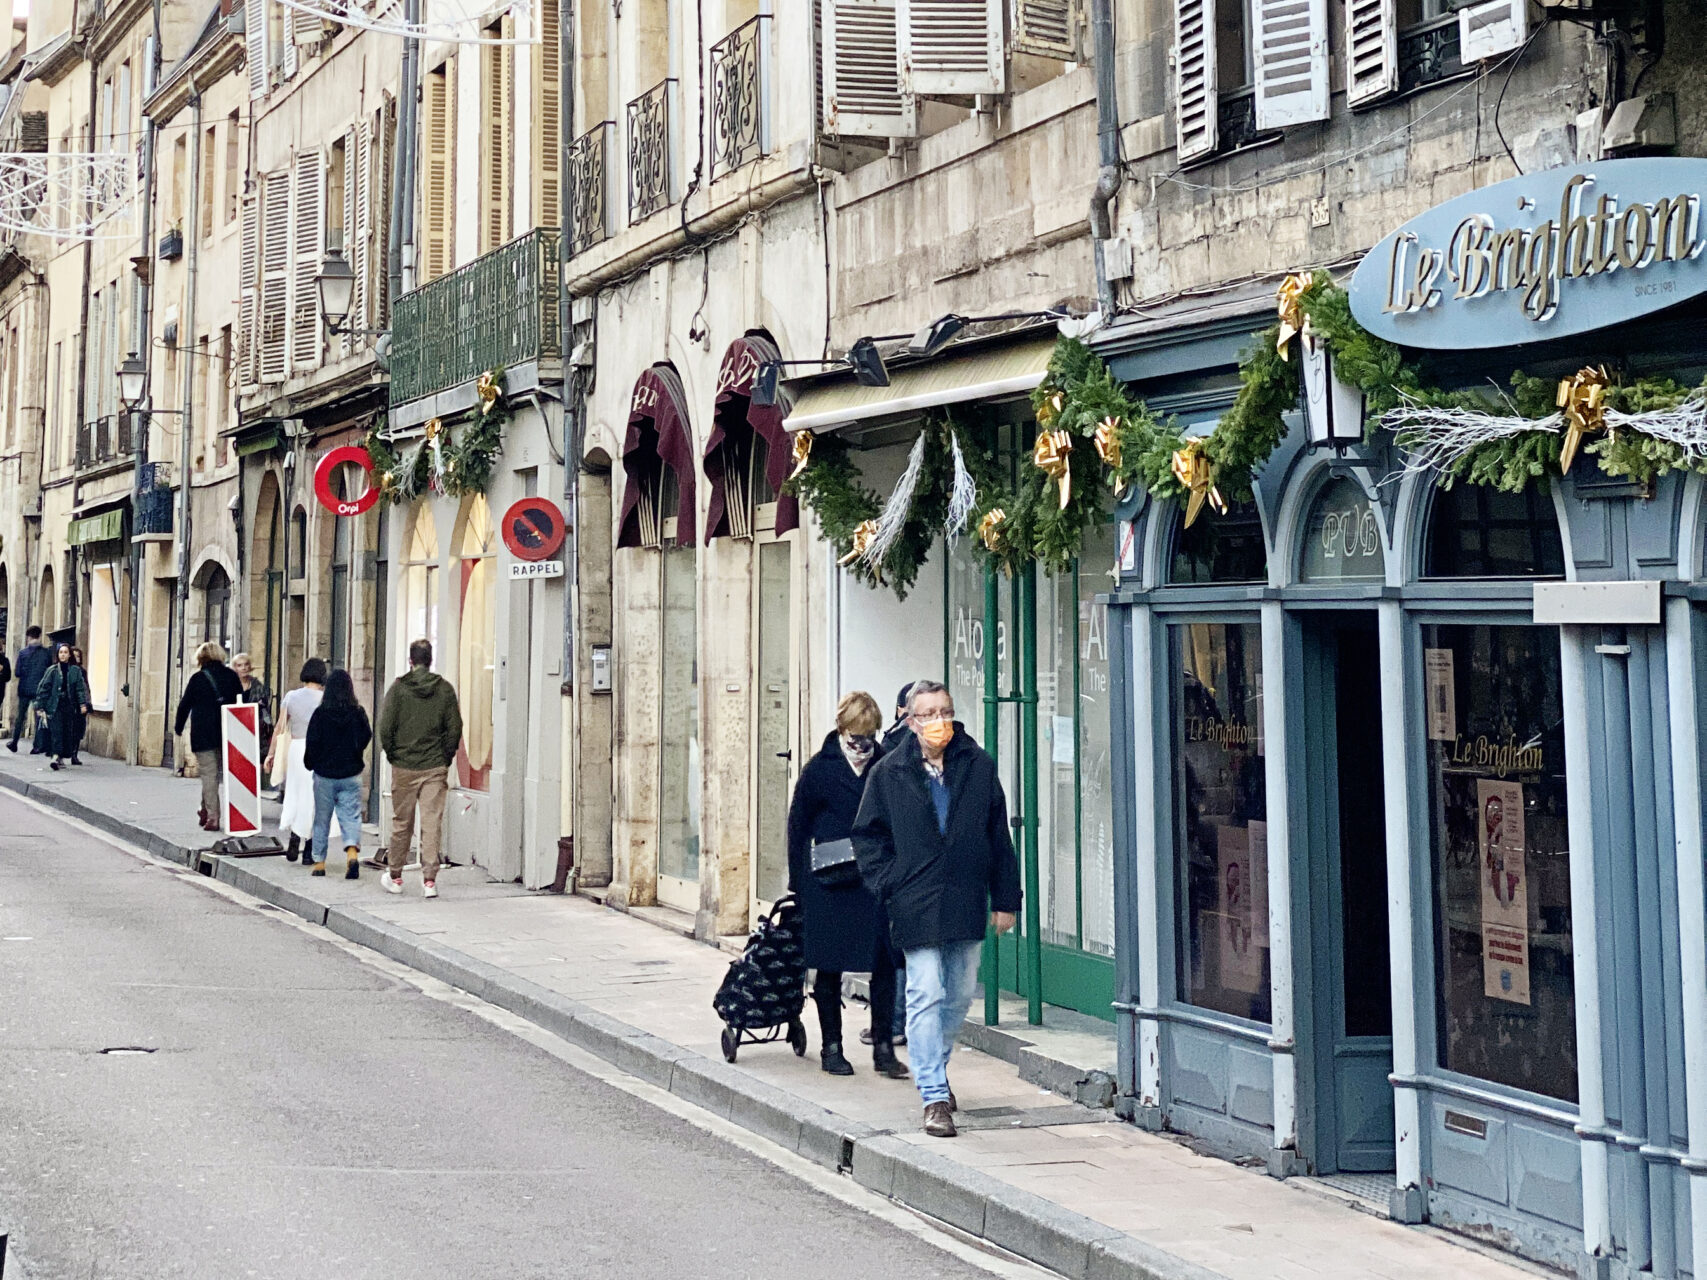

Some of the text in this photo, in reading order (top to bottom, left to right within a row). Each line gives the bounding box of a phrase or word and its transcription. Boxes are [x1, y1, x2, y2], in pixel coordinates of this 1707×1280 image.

[1382, 174, 1700, 322] Le Brighton
[1634, 280, 1677, 297] SINCE 1981
[338, 502, 359, 515] Orpi
[1321, 504, 1378, 559] PUB
[512, 564, 559, 576] RAPPEL
[953, 606, 1007, 661] Aloa
[956, 664, 970, 687] The
[1089, 668, 1106, 692] The
[1189, 714, 1254, 752] Le Brighton
[1452, 732, 1544, 778] Le Brighton
